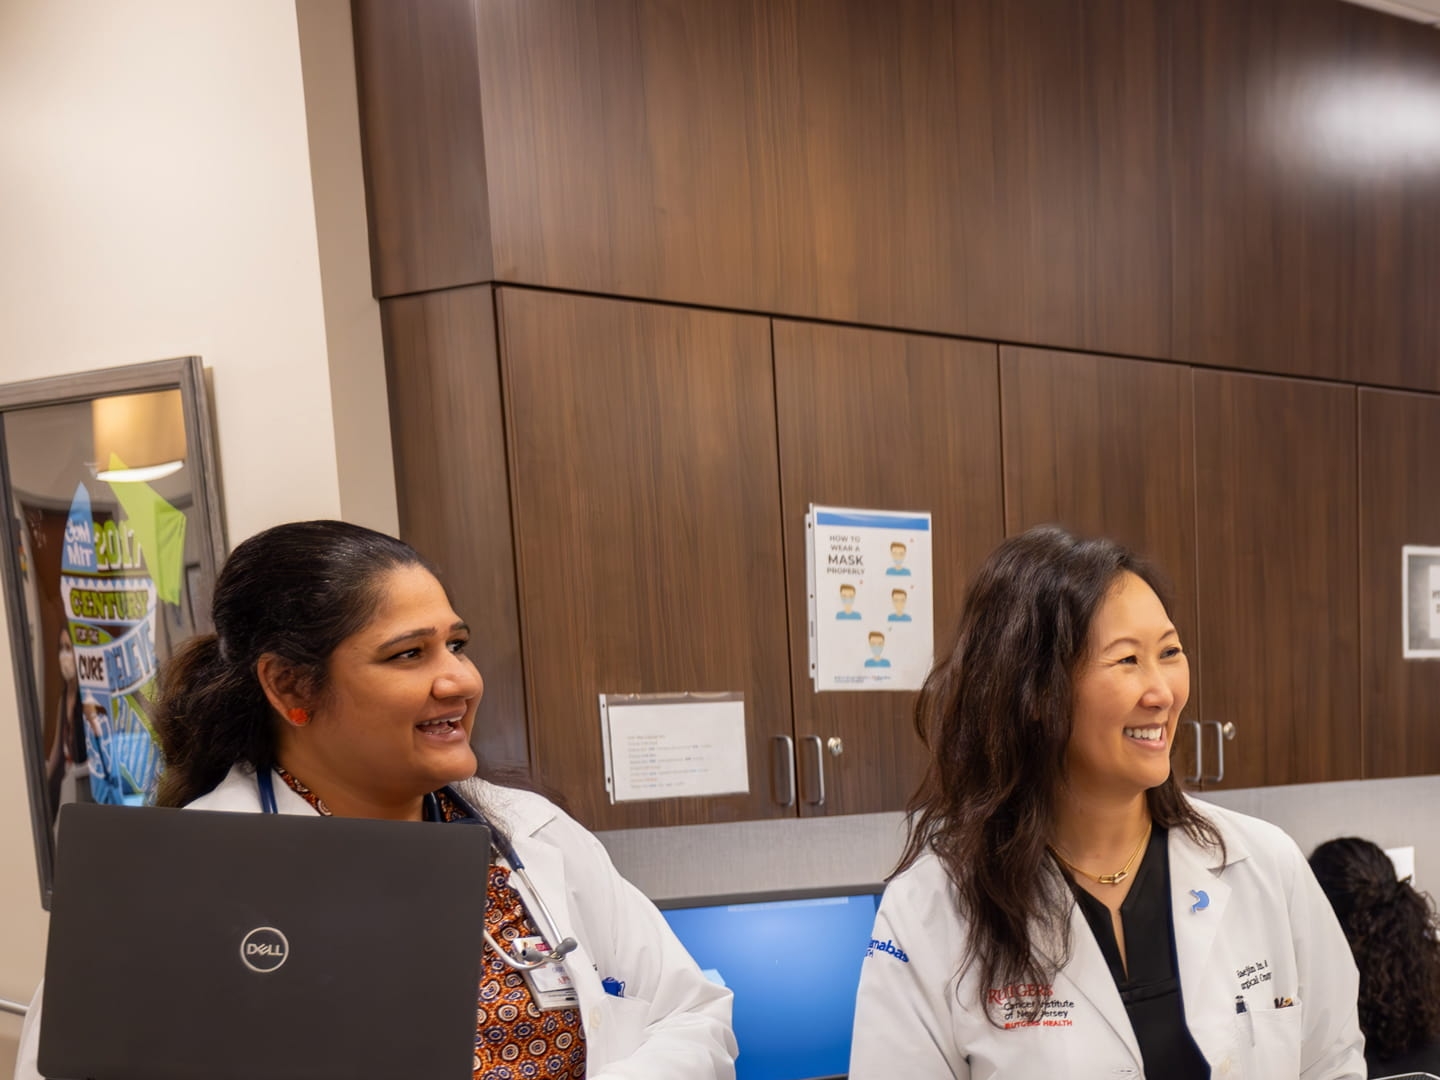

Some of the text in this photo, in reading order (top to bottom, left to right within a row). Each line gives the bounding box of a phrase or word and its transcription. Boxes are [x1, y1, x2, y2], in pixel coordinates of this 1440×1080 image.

[850, 535, 861, 543] TO
[831, 544, 853, 552] WEAR
[828, 553, 864, 566] MASK
[826, 567, 865, 575] PROPERLY
[69, 588, 150, 620] CENTURY
[78, 654, 105, 682] CURE
[246, 943, 284, 956] DELL
[988, 983, 1054, 1005] RUTGERS
[1004, 1000, 1075, 1010] Cancer nstitute
[1004, 1010, 1014, 1020] of
[1016, 1010, 1036, 1019] New
[1004, 1020, 1041, 1029] RUTGERS
